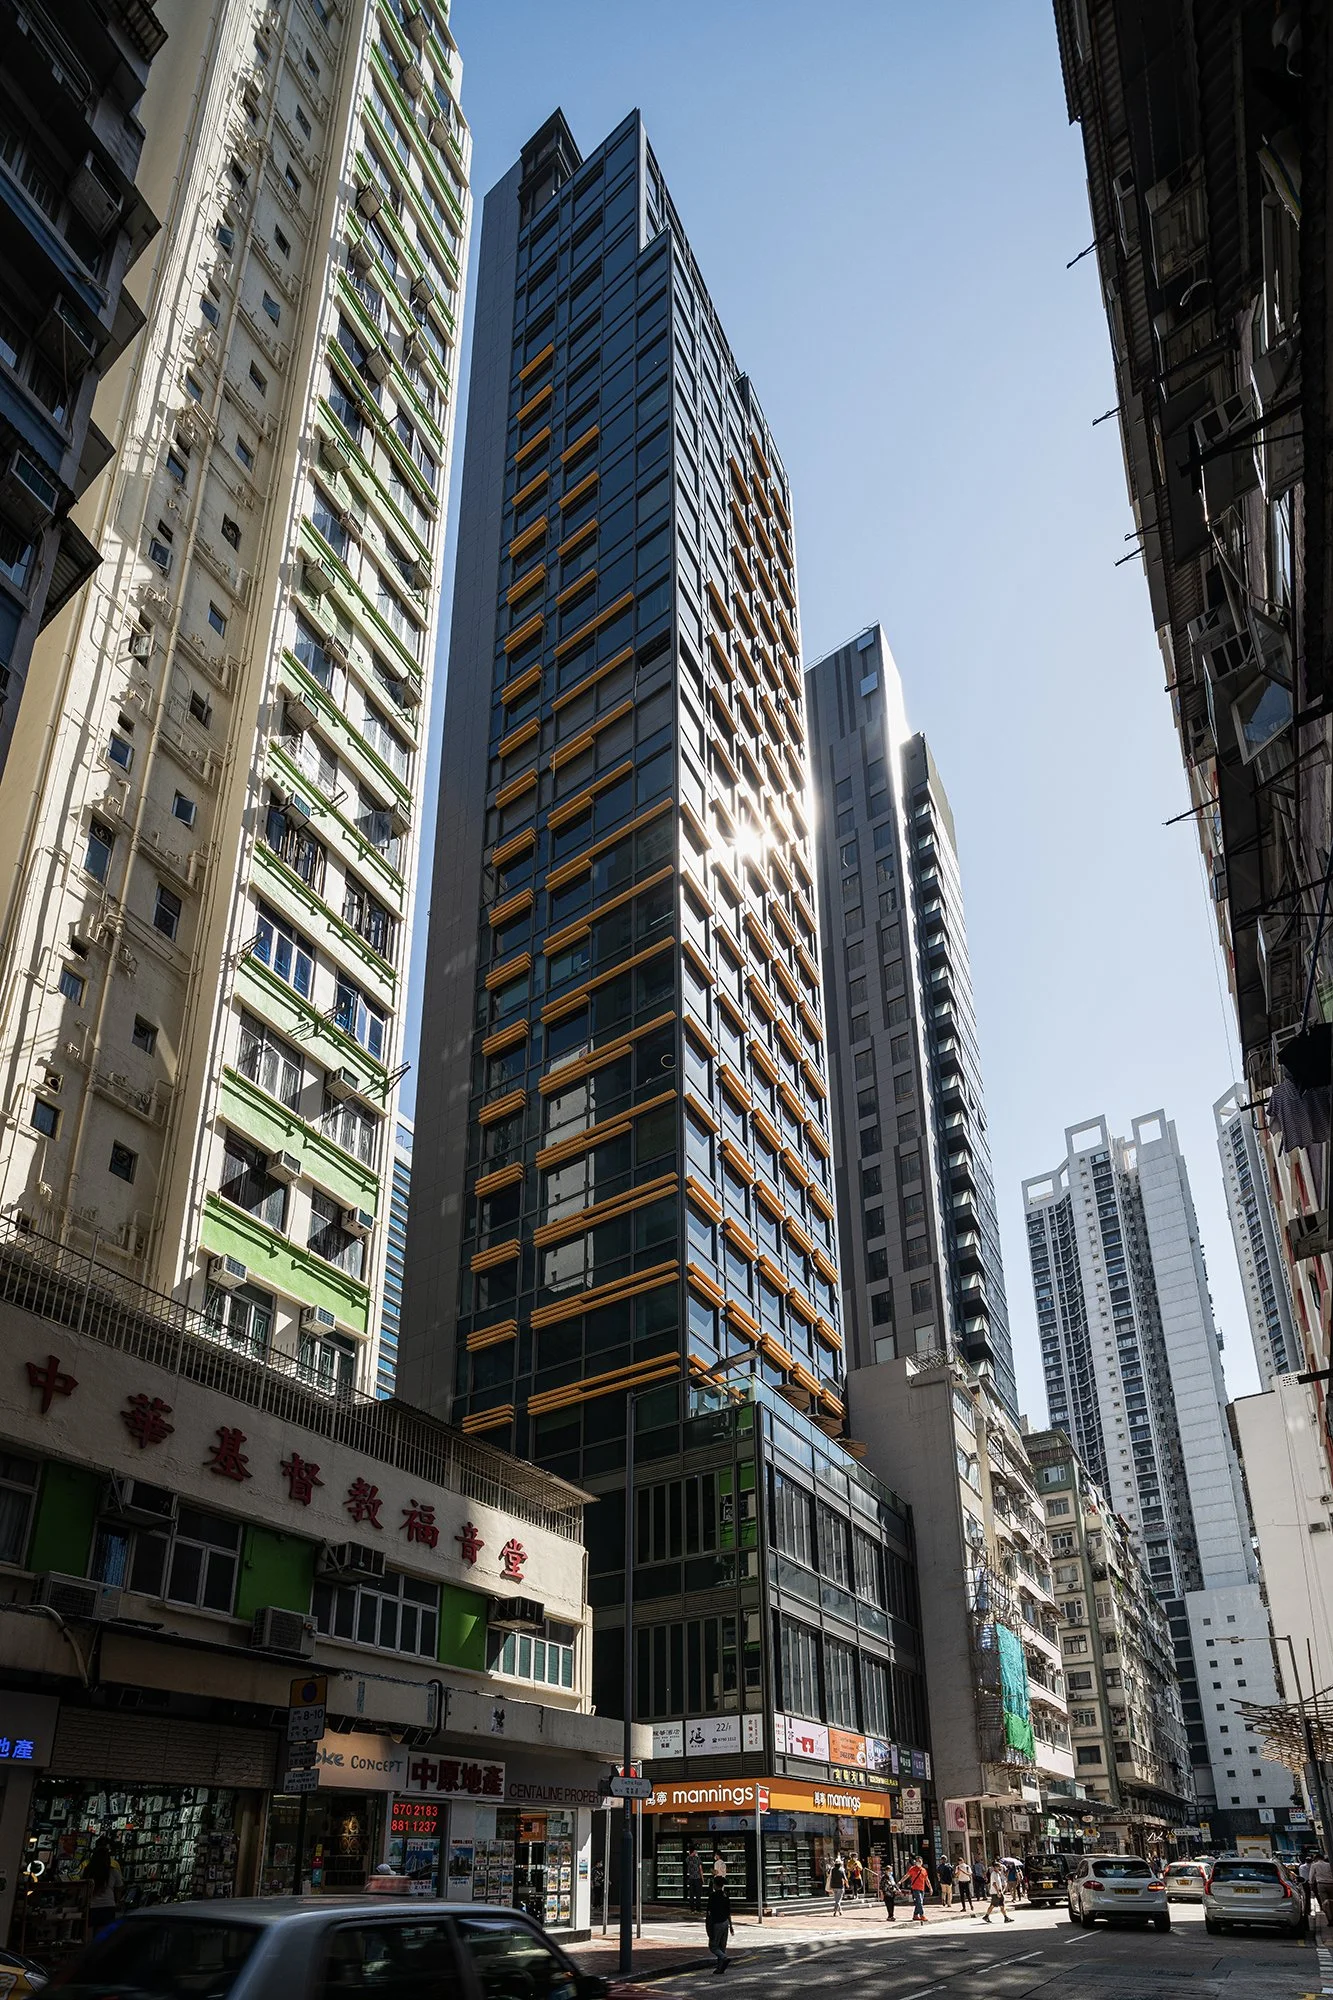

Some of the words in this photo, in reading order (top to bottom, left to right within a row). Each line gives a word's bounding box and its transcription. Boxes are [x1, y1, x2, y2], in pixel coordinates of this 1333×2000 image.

[25, 1354, 528, 1583] 中華基督教福音堂
[303, 1708, 324, 1720] 8-10
[302, 1725, 320, 1736] 5-7
[411, 1758, 504, 1796] 中原地產
[510, 1783, 563, 1800] CENTALINE
[673, 1785, 754, 1805] mannings
[393, 1803, 412, 1815] 670
[413, 1805, 438, 1817] 2183
[827, 1792, 861, 1811] mannings
[391, 1819, 409, 1831] 881
[413, 1821, 437, 1833] 1237
